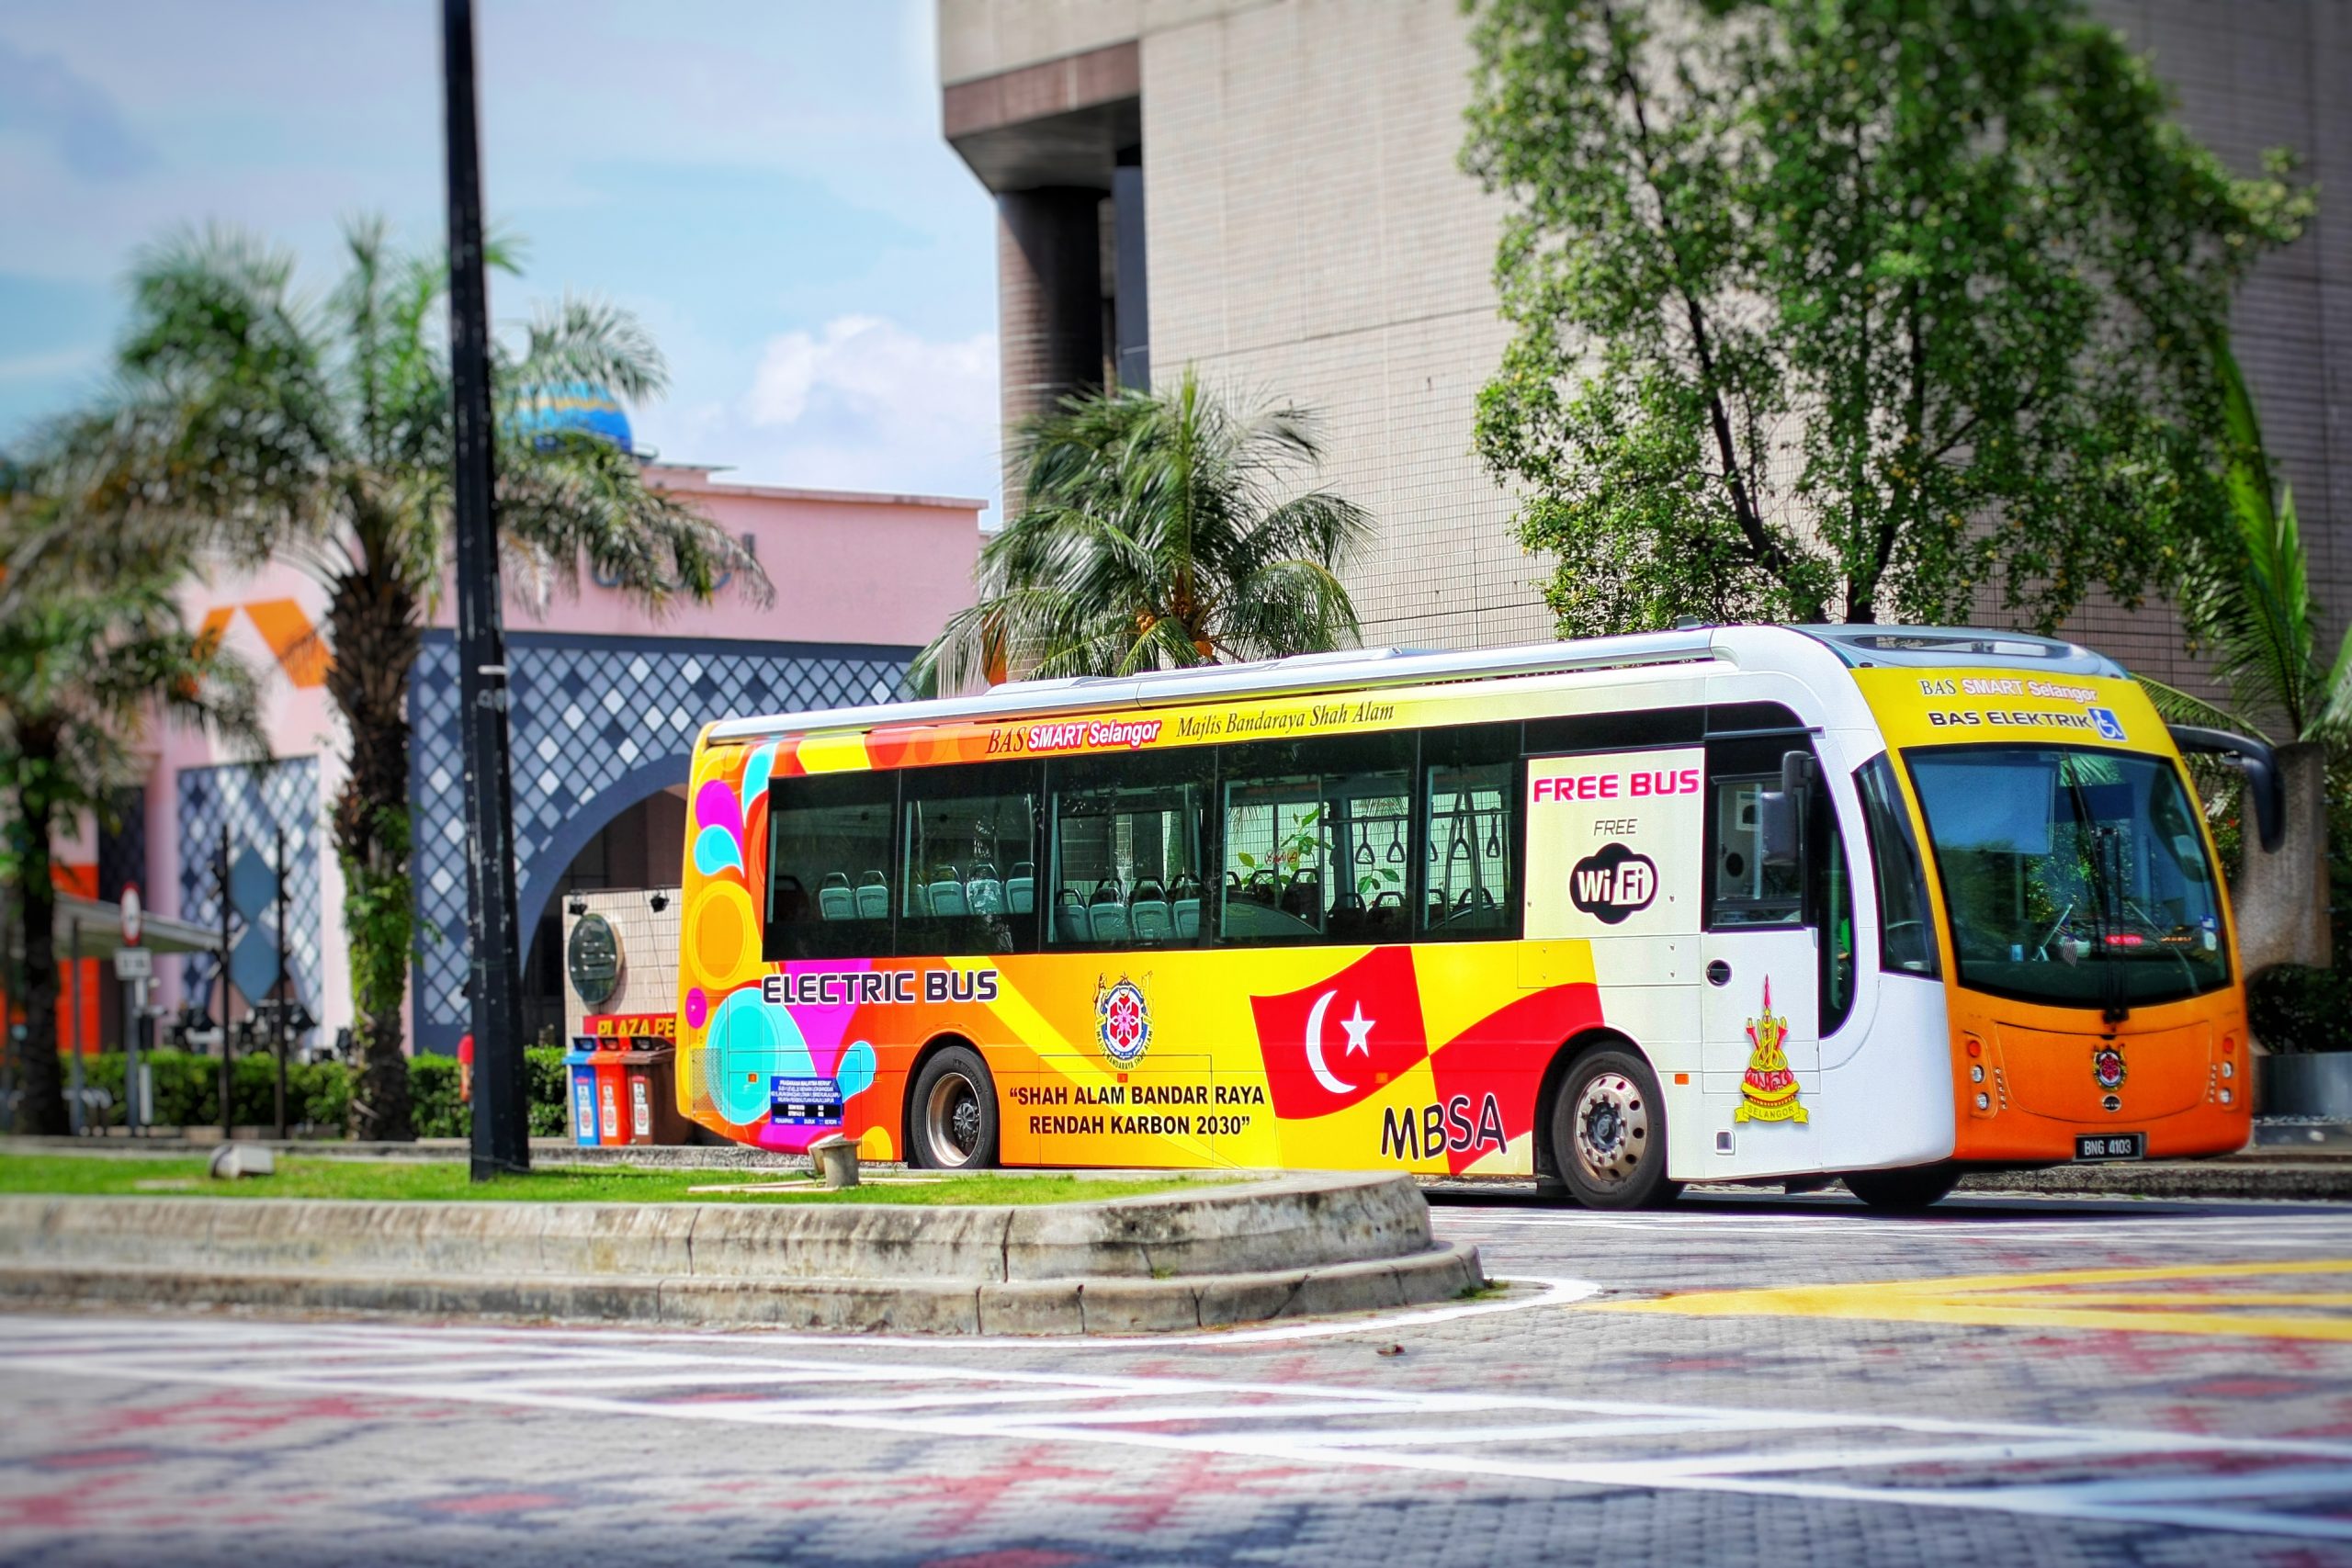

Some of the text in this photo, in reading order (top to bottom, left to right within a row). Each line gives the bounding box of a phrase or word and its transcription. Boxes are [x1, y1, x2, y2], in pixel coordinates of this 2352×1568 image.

[1920, 678, 2098, 703] BAS SMART Selangor
[1176, 701, 1395, 740] Majlis Bandaraya Shah Alam
[1928, 711, 2093, 728] BAS ELEKTRIK
[985, 720, 1162, 754] BAS SMART Selangor
[1533, 769, 1700, 803] FREE BUS
[1593, 818, 1638, 836] FREE
[763, 970, 998, 1004] ELECTRIC BUS
[1074, 1087, 1125, 1104] ALAM
[1132, 1086, 1208, 1104] BANDAR
[1215, 1086, 1265, 1104] RAYA
[1747, 1105, 1795, 1119] SELANGOR
[1030, 1116, 1103, 1134] RENDAH
[1111, 1116, 1190, 1134] KARBON
[1381, 1093, 1508, 1160] MBSA
[2084, 1139, 2132, 1156] BNG 4103
